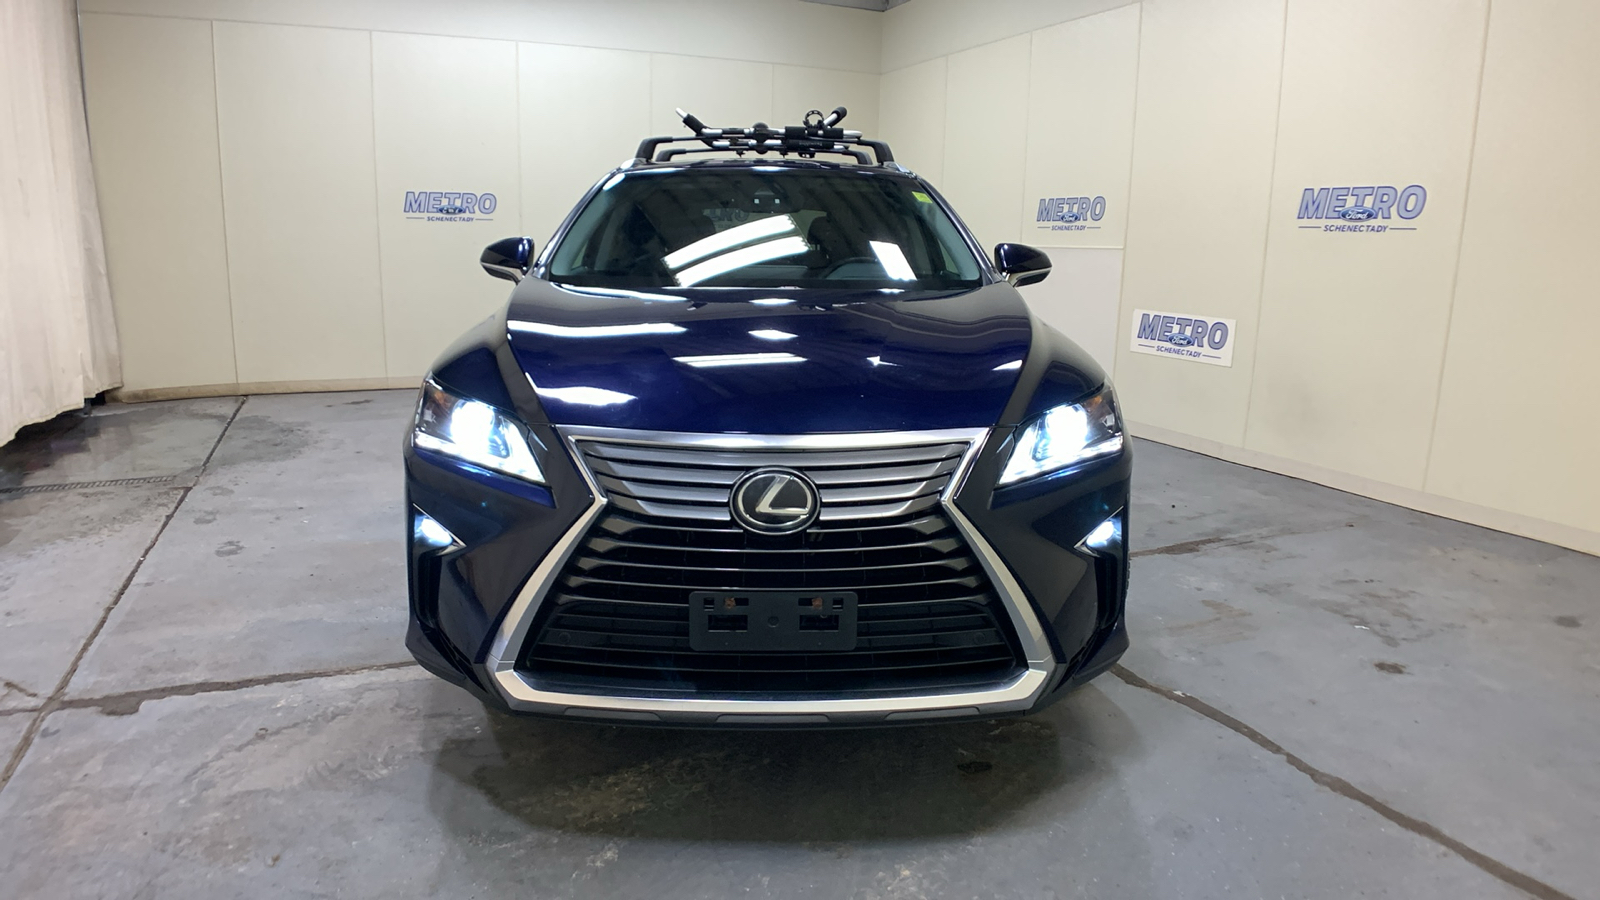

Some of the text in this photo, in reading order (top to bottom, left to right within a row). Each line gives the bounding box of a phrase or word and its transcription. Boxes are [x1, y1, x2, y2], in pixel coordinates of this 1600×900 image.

[403, 191, 497, 215] METRO
[1036, 195, 1107, 222] METRO
[1297, 184, 1428, 220] METRO
[1345, 209, 1369, 220] Ford
[1323, 224, 1389, 233] SCHENECTADY
[1137, 313, 1229, 350] METRO
[1155, 345, 1203, 358] SCHENECTADY
